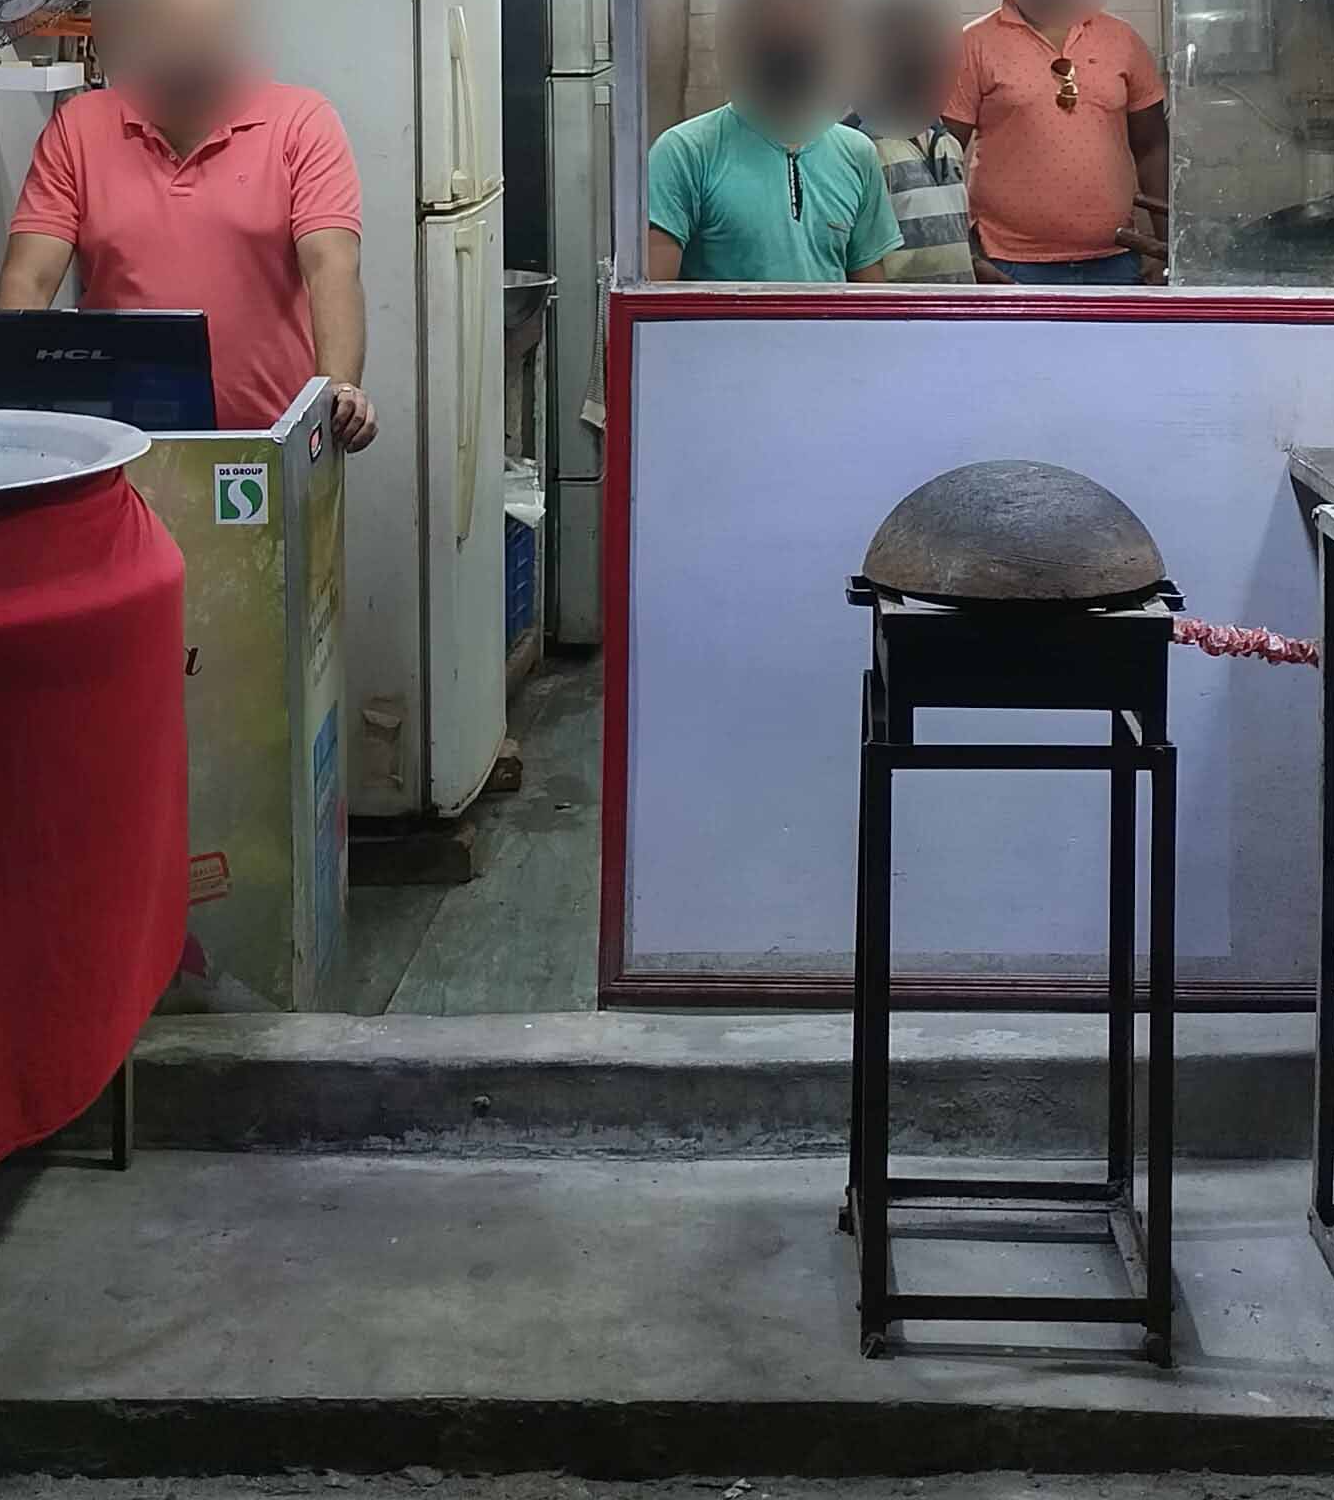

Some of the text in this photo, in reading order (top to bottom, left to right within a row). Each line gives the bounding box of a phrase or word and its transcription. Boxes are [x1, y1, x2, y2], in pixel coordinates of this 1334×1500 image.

[36, 349, 115, 360] HCL
[219, 467, 264, 476] DS GROUP
